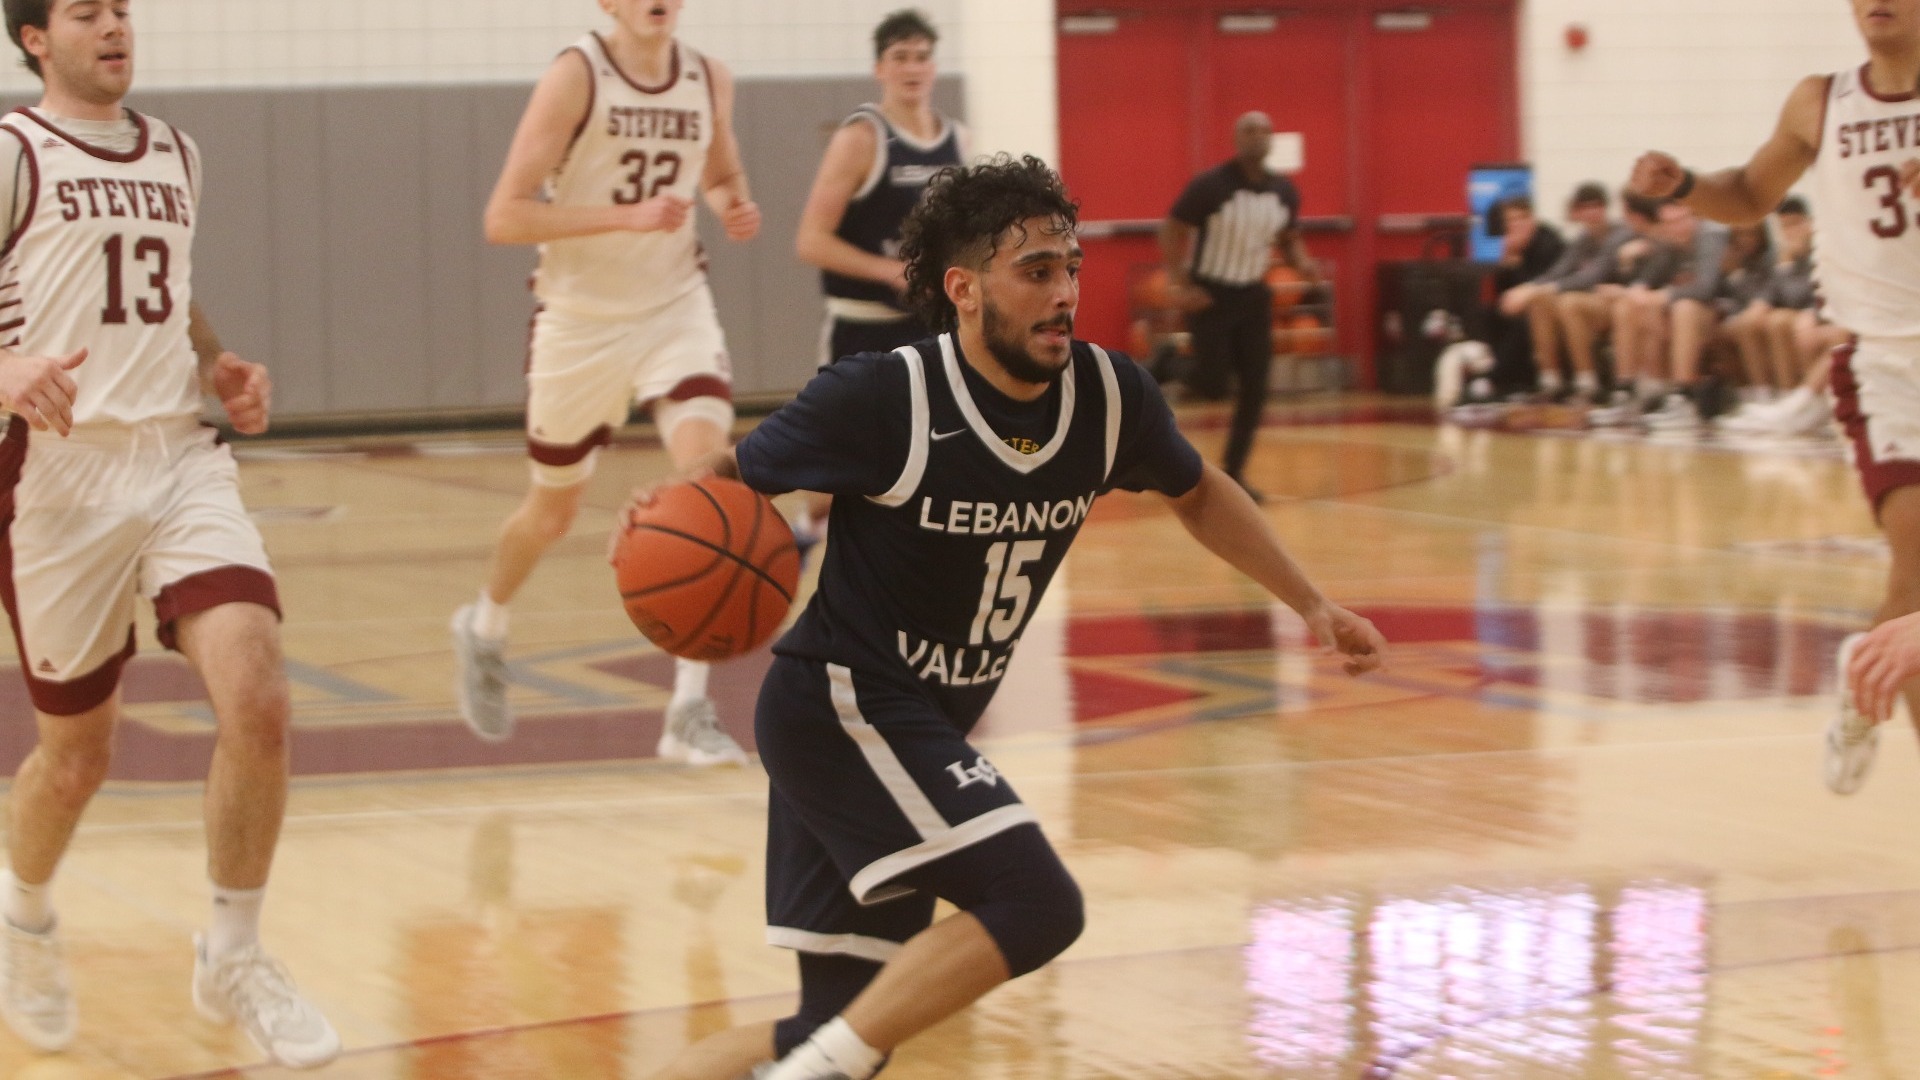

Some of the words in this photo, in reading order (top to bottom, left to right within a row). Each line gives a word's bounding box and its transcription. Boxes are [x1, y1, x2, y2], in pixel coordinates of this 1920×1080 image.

[608, 106, 699, 140] STEVENS
[57, 178, 190, 227] STEVENS
[102, 234, 173, 325] 13
[920, 490, 1096, 535] LEBANON
[969, 539, 1047, 645] 15
[898, 629, 1018, 686] VALLE
